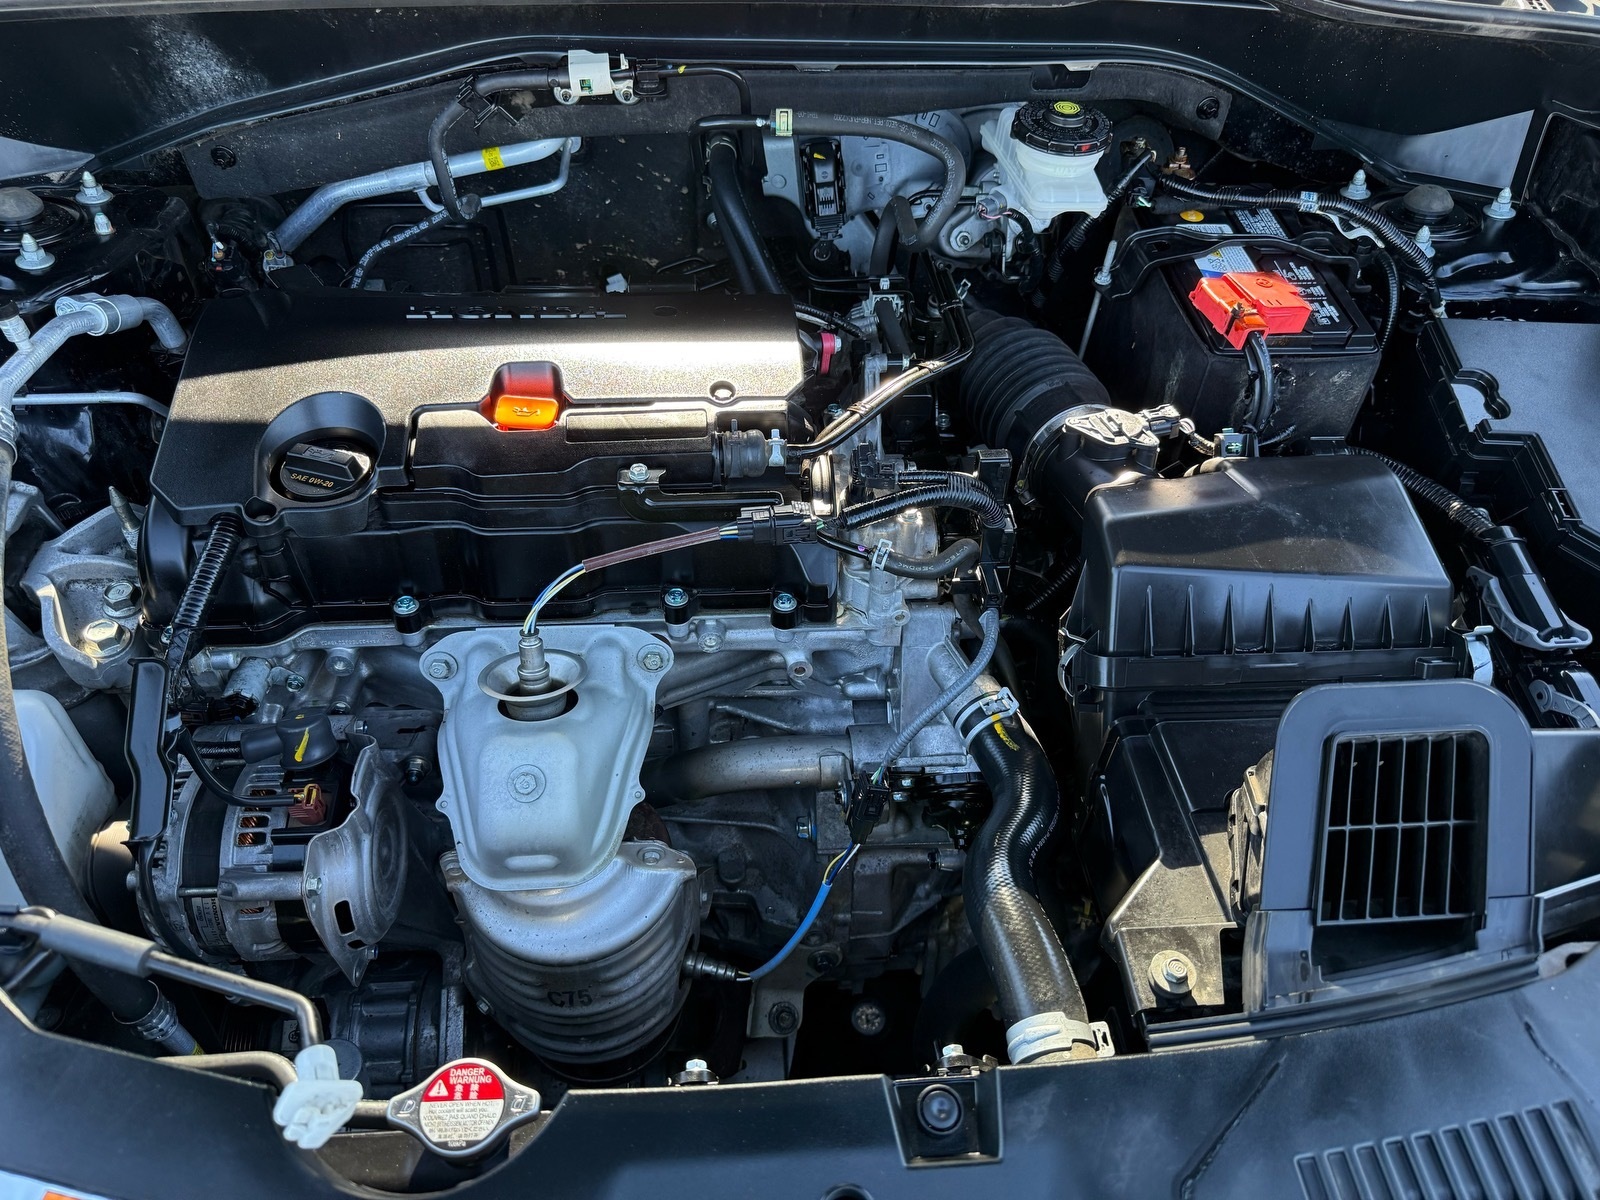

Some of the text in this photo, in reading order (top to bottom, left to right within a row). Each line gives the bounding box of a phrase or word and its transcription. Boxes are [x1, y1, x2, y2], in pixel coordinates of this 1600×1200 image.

[290, 472, 334, 488] SAE 0W-20
[211, 898, 220, 926] HONDA
[450, 1067, 485, 1077] DANGER
[449, 1075, 492, 1084] WARNUNG
